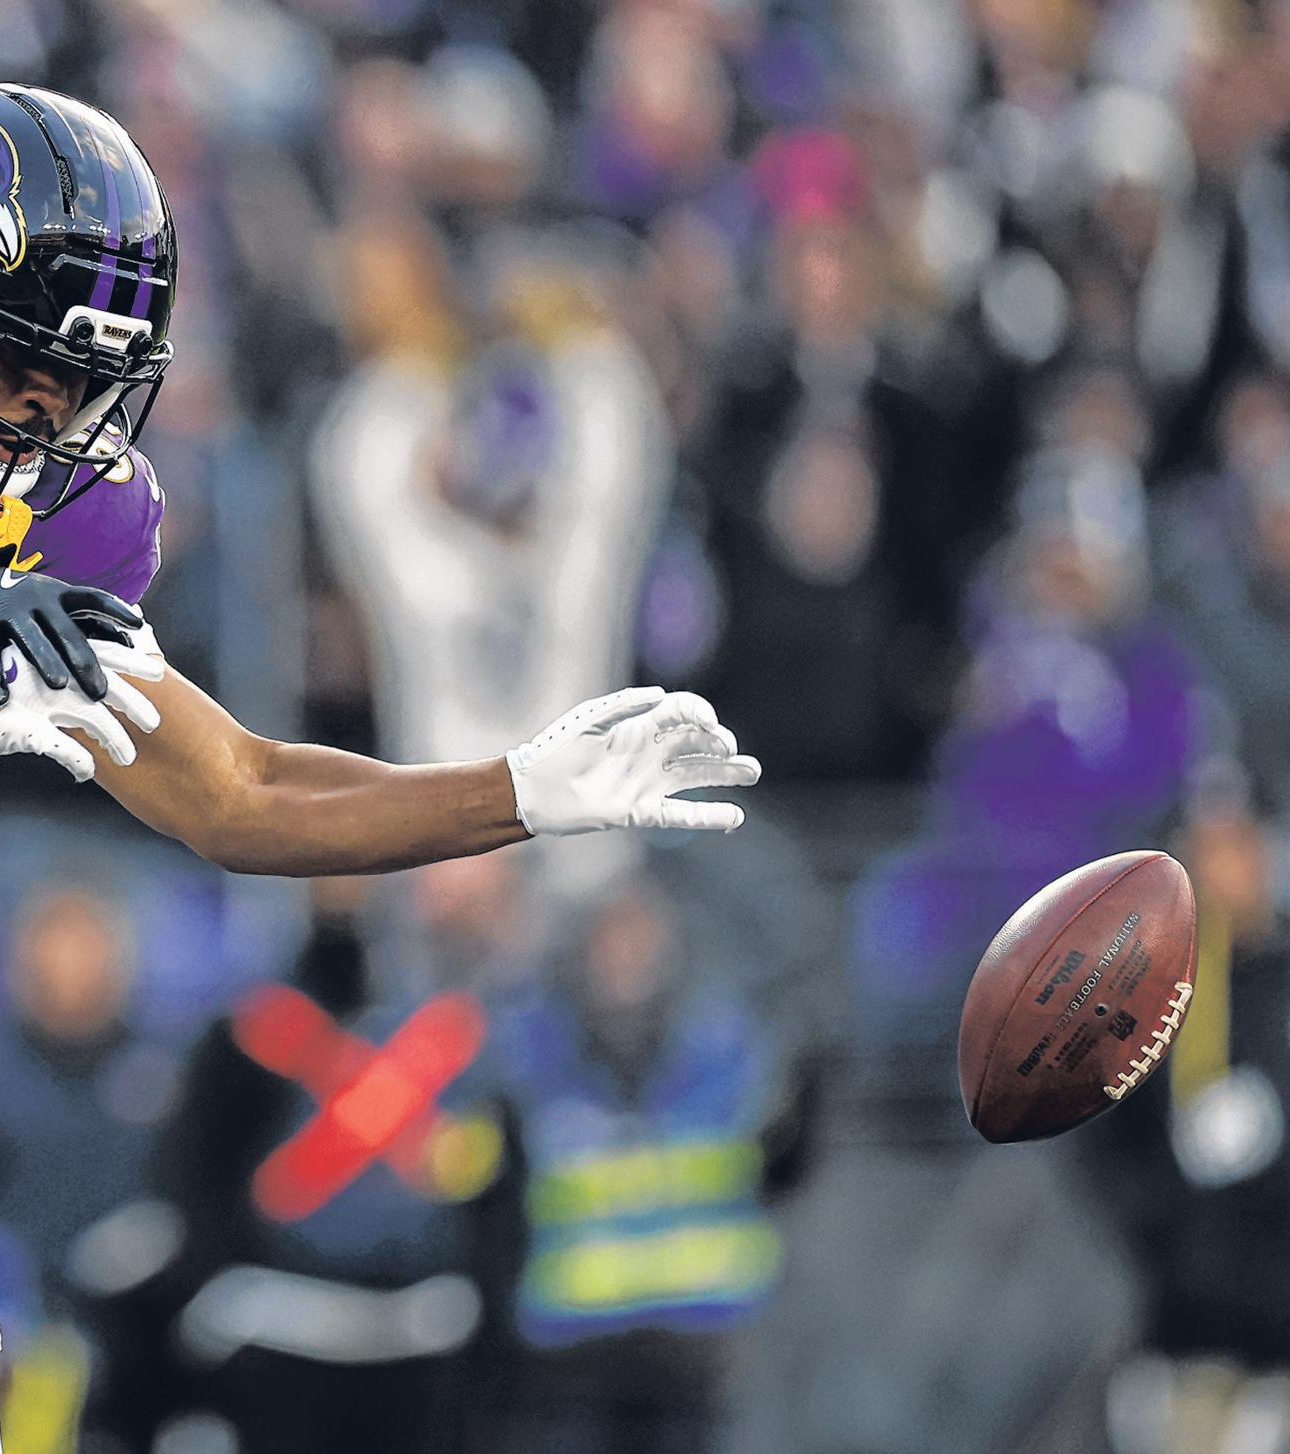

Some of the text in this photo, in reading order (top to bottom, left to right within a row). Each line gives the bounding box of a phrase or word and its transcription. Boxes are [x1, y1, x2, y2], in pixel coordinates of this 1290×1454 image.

[103, 324, 133, 340] RAVENS
[1099, 912, 1140, 968] NATIONAL
[1056, 970, 1102, 1030] FOOTBALL
